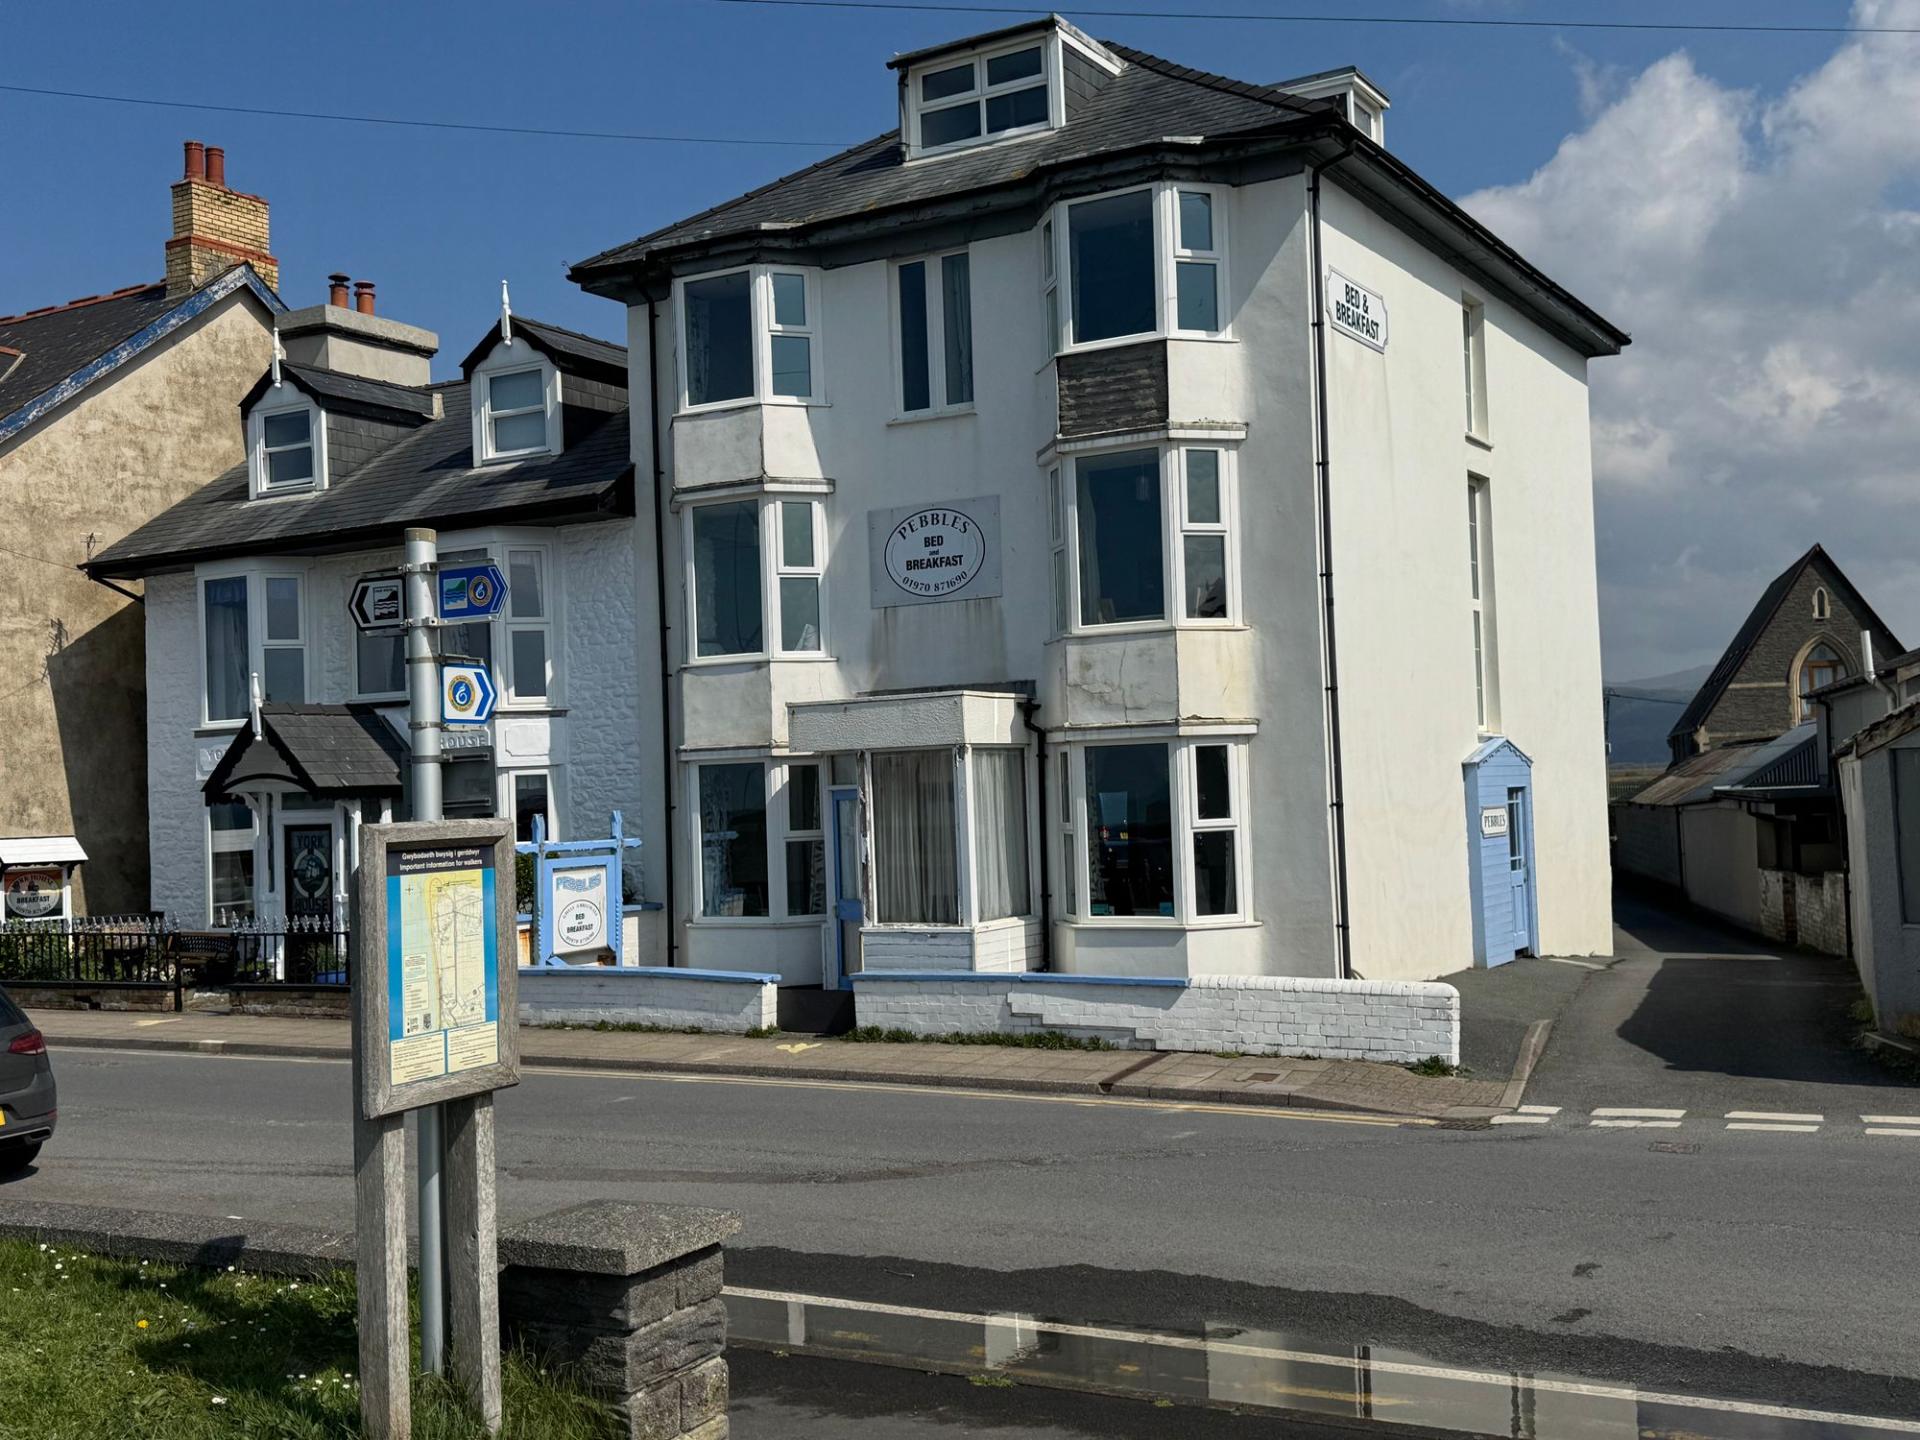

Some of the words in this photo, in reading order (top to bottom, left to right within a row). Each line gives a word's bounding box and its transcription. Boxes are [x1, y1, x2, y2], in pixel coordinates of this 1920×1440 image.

[1344, 283, 1360, 309] BED
[1362, 294, 1369, 315] &
[1335, 299, 1380, 341] BREAKFAST
[897, 512, 971, 541] PEBBLES
[923, 535, 944, 548] BED
[905, 555, 964, 571] BREAKFAST
[902, 576, 931, 592] 01970
[933, 570, 968, 592] 871690
[1484, 814, 1506, 828] PEBBLES
[296, 835, 324, 849] YORK
[399, 863, 425, 871] Important
[425, 860, 455, 869] information
[295, 897, 329, 912] HOUSE
